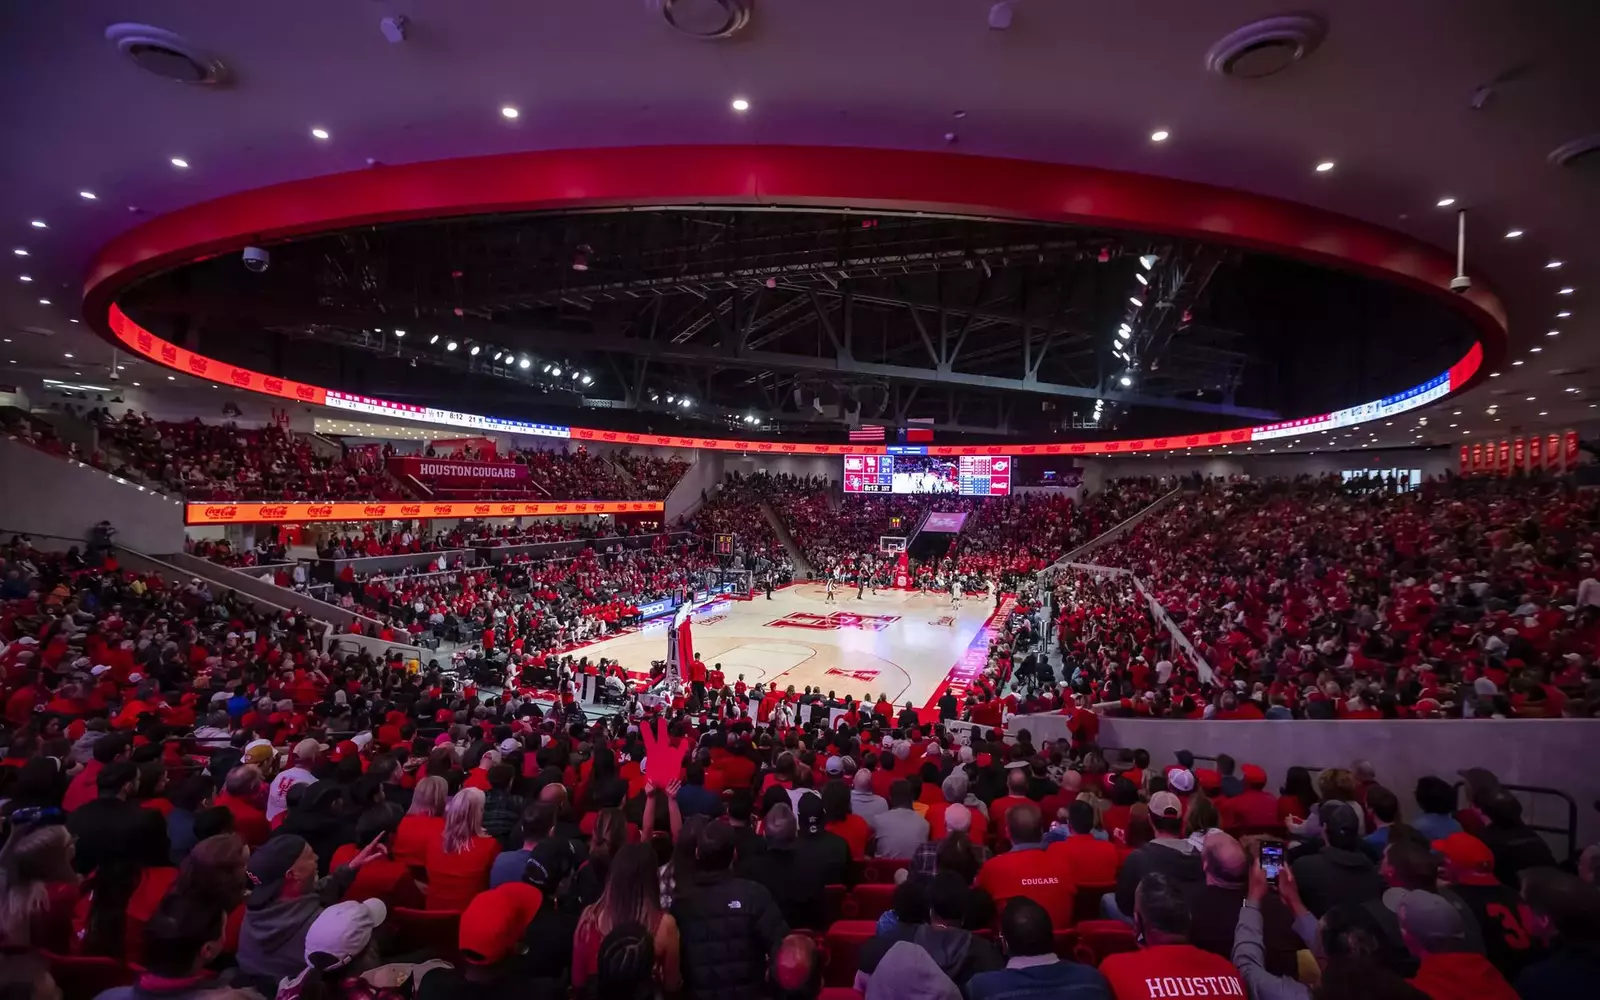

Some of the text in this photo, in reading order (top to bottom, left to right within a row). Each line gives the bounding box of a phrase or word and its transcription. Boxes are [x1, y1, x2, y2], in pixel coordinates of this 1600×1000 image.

[449, 412, 463, 420] 8:12
[420, 463, 516, 478] HOUSTON COUGARS
[1021, 877, 1059, 886] COUGARS
[1145, 976, 1244, 998] HOUSTON
